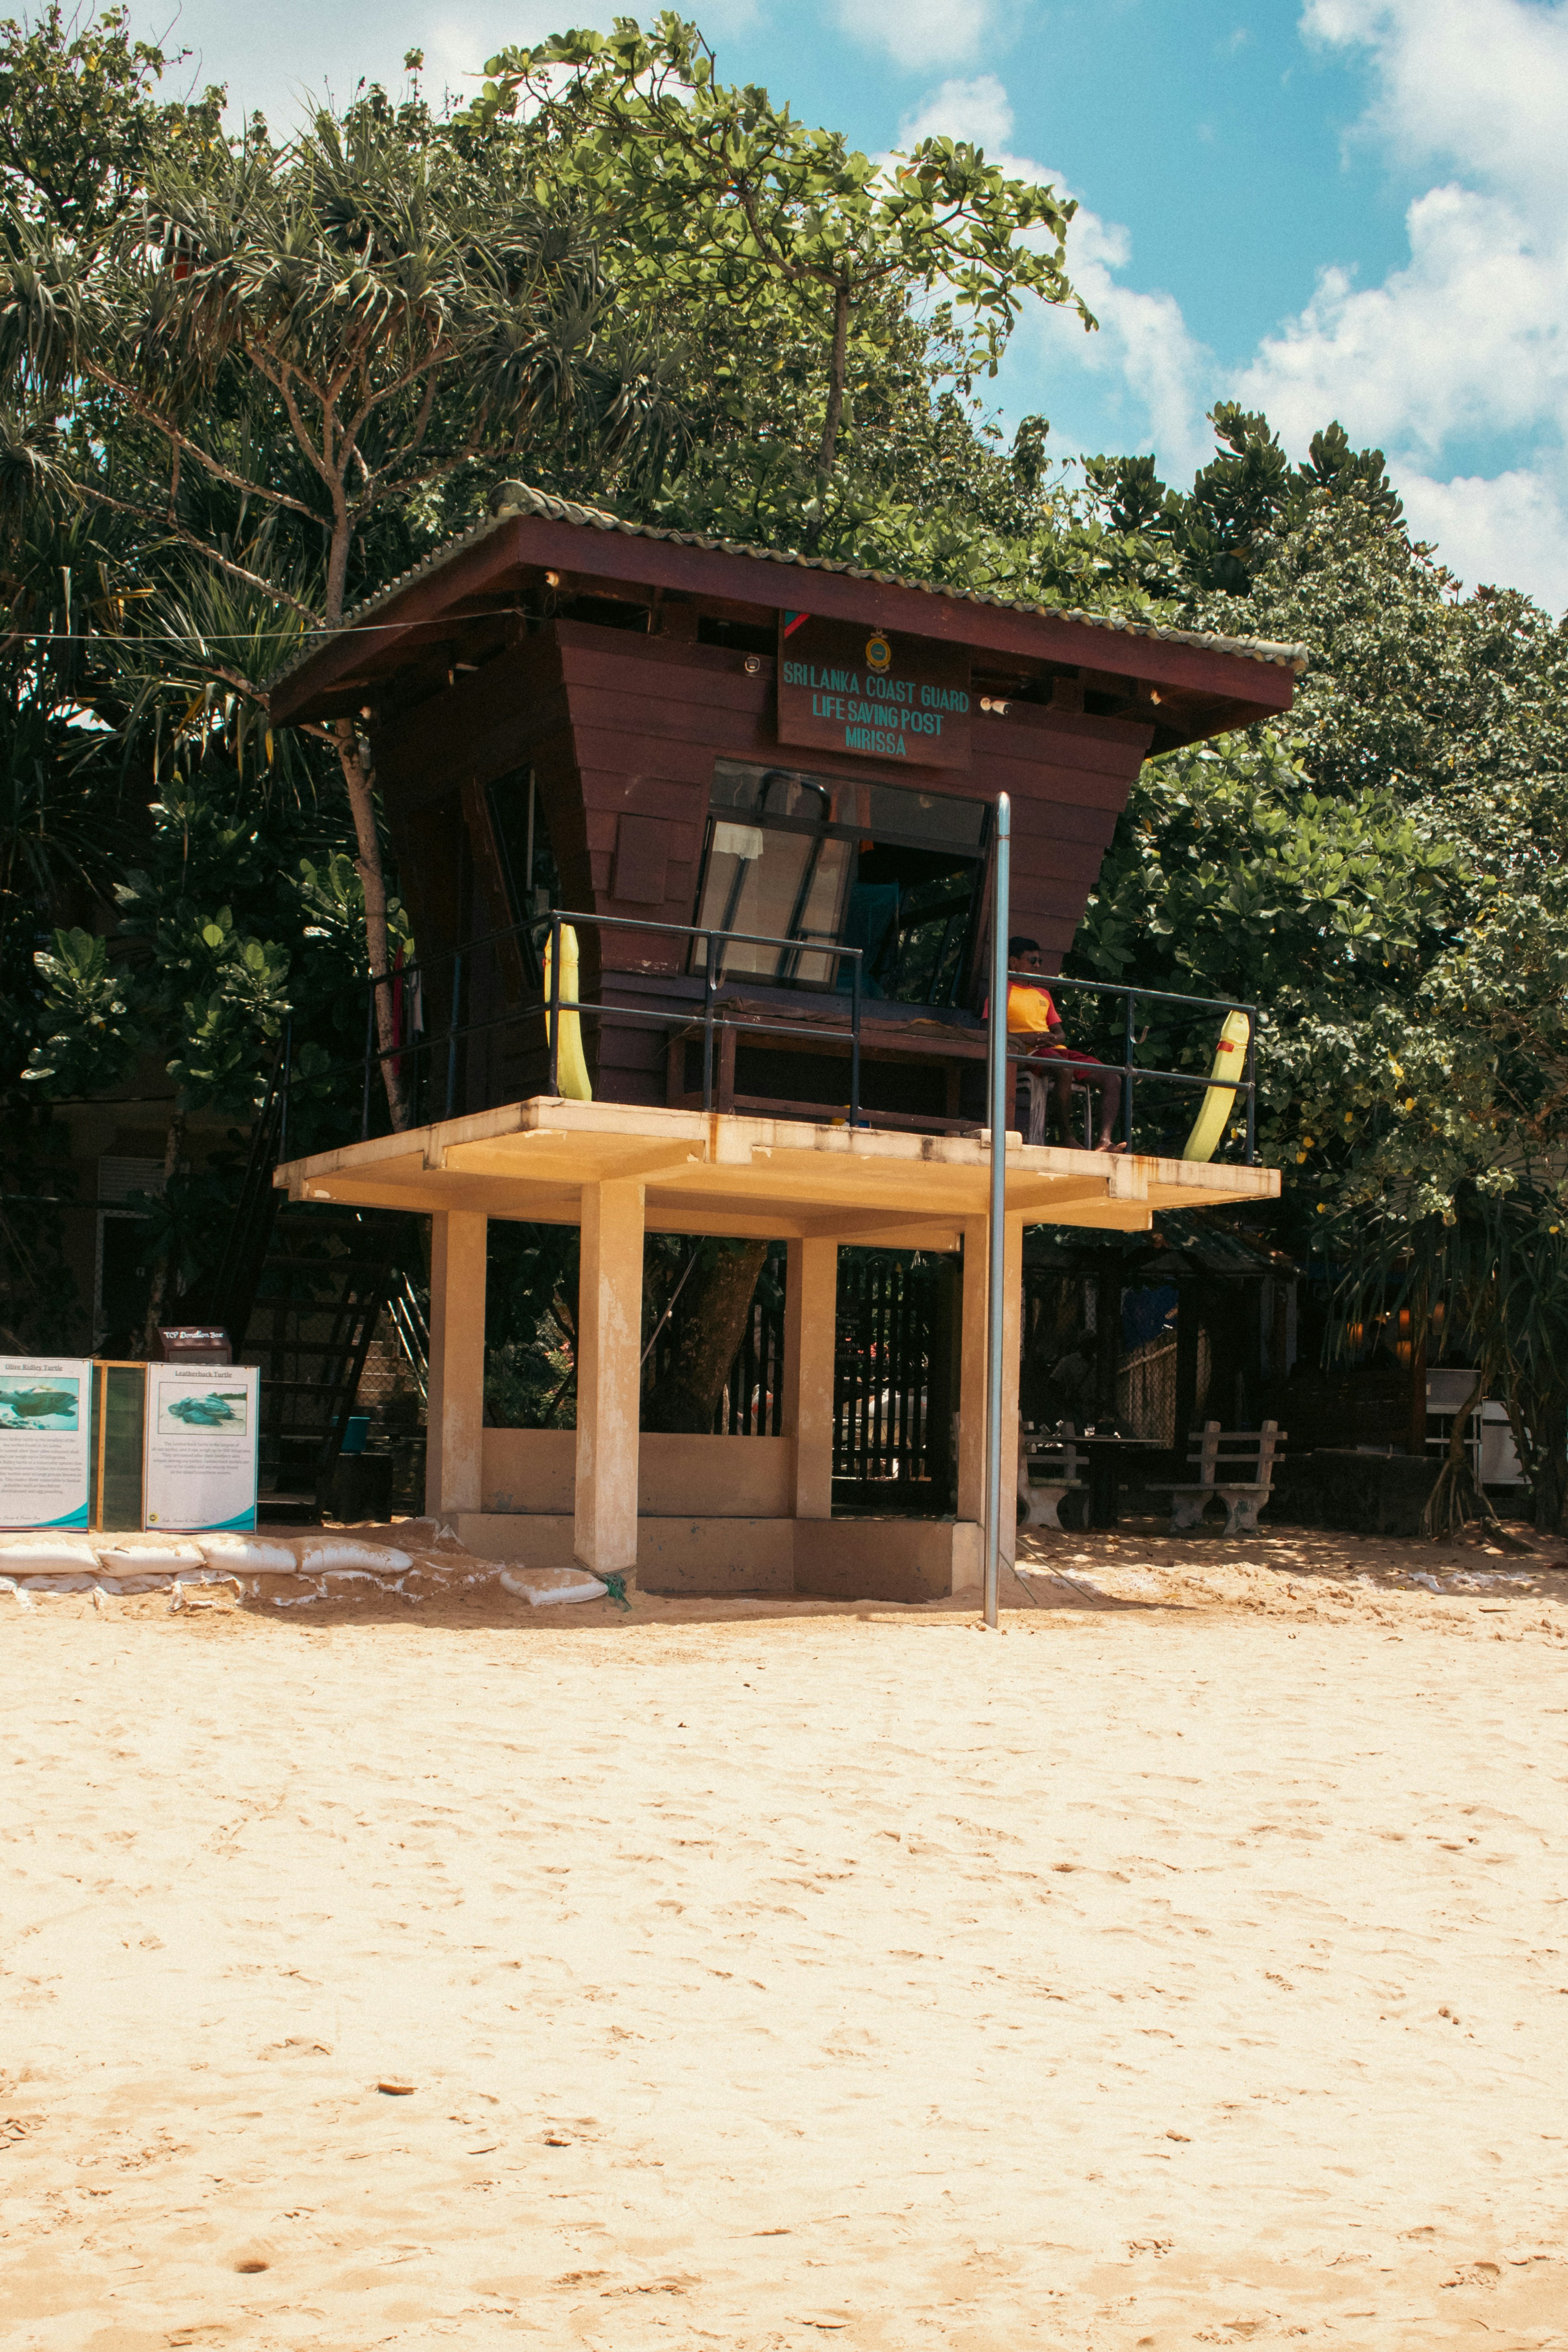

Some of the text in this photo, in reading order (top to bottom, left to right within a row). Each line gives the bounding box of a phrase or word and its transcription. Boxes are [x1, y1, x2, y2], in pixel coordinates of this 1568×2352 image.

[784, 661, 969, 713] SRI LANKA COAST GUARD
[813, 694, 943, 736] LIFE SAVING POST
[845, 726, 906, 756] MIRISSA
[179, 1330, 209, 1339] Donation
